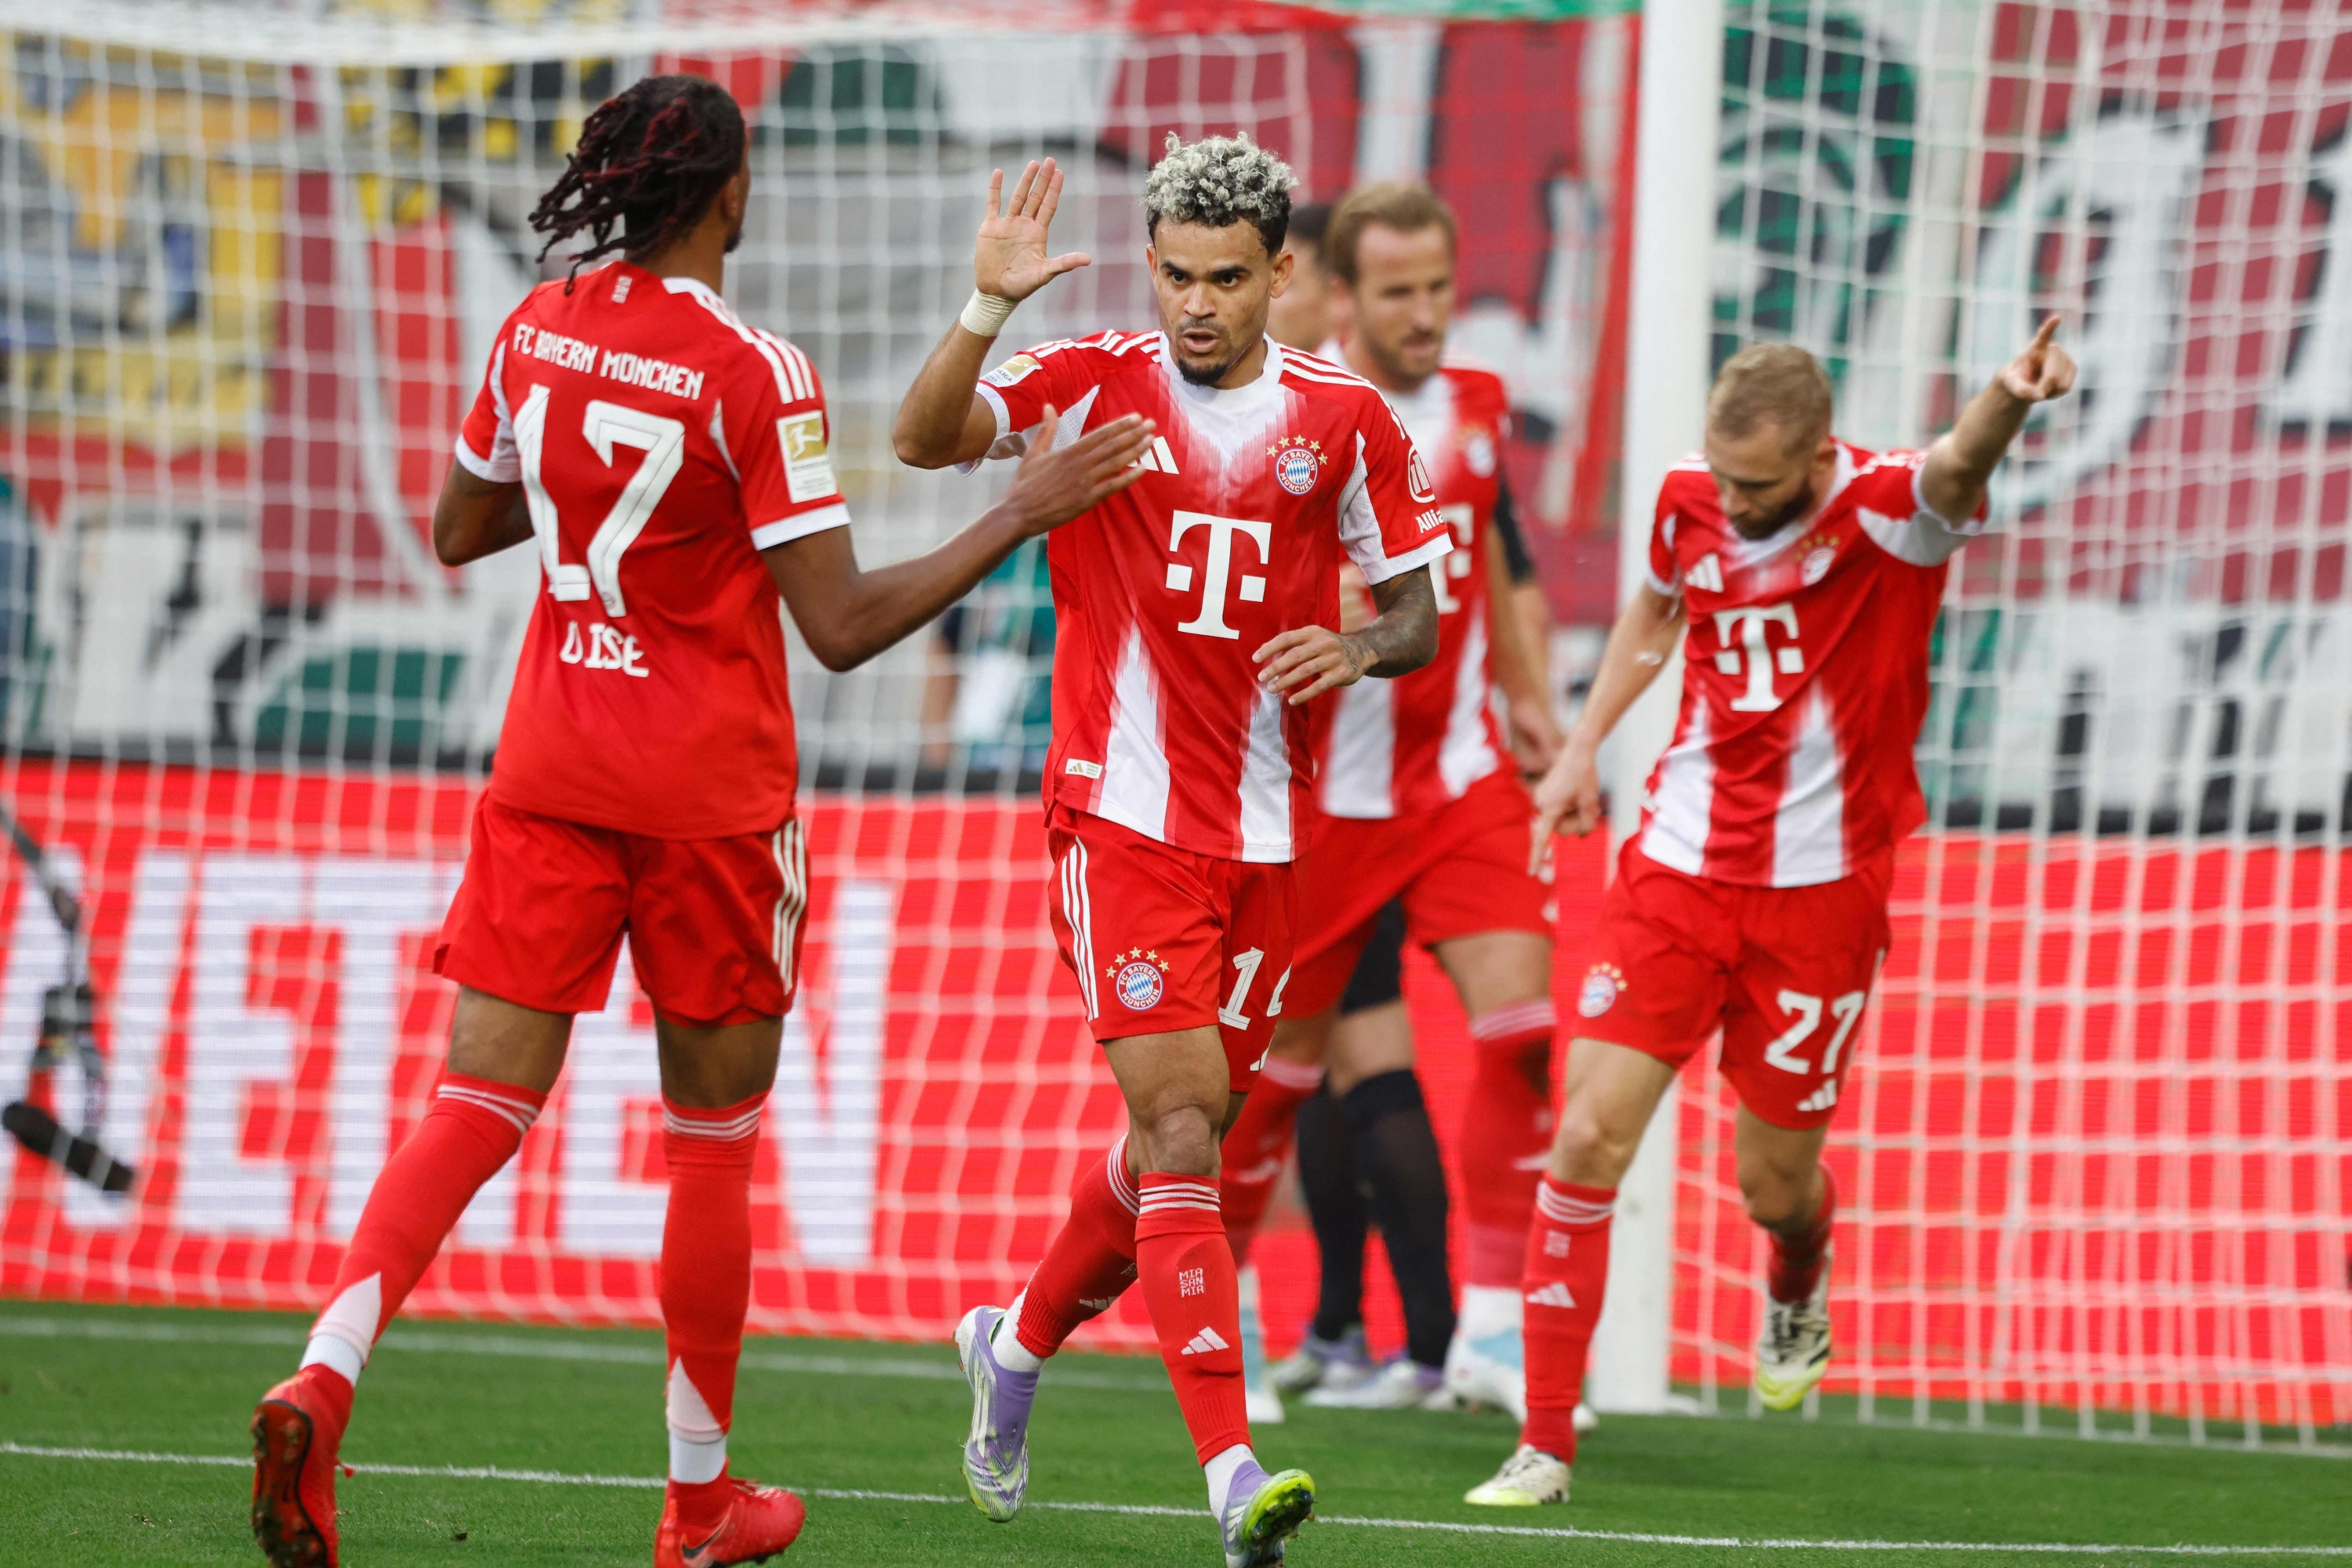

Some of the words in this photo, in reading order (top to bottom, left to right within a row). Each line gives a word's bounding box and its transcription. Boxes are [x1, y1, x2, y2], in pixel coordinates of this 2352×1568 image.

[513, 323, 535, 354] FC
[533, 330, 598, 373] BAYERN
[600, 350, 705, 400] MÜNCHEN
[1280, 456, 1290, 466] FC
[1290, 452, 1316, 471] BAYERN
[513, 383, 685, 617] 17
[1120, 974, 1128, 985] FC
[1127, 965, 1158, 982] BAYERN
[1764, 989, 1865, 1075] 27
[1179, 1268, 1203, 1280] MIA
[1180, 1276, 1204, 1288] SAN
[1181, 1284, 1204, 1298] MIA
